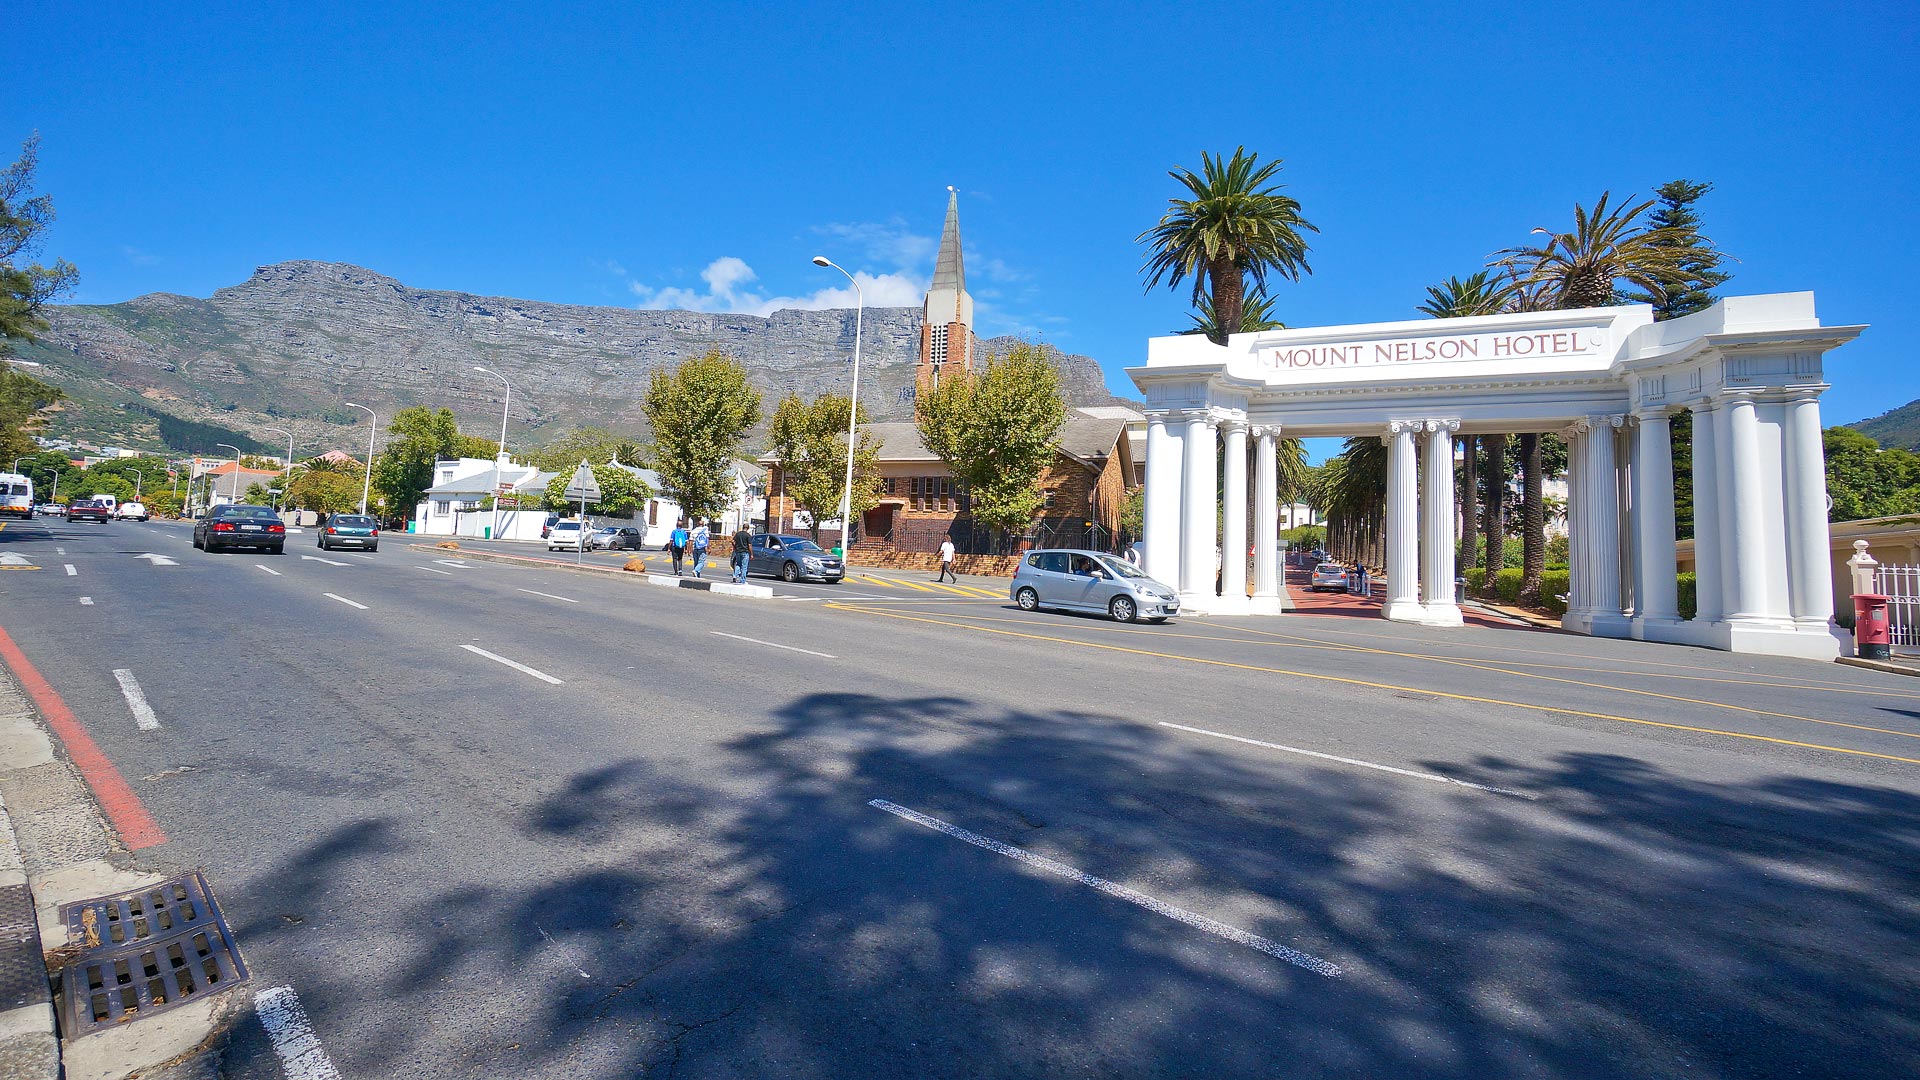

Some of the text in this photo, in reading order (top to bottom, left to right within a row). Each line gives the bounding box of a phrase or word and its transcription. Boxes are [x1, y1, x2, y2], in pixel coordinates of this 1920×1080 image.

[1275, 332, 1588, 369] MOUNT NELSON HOTEL
